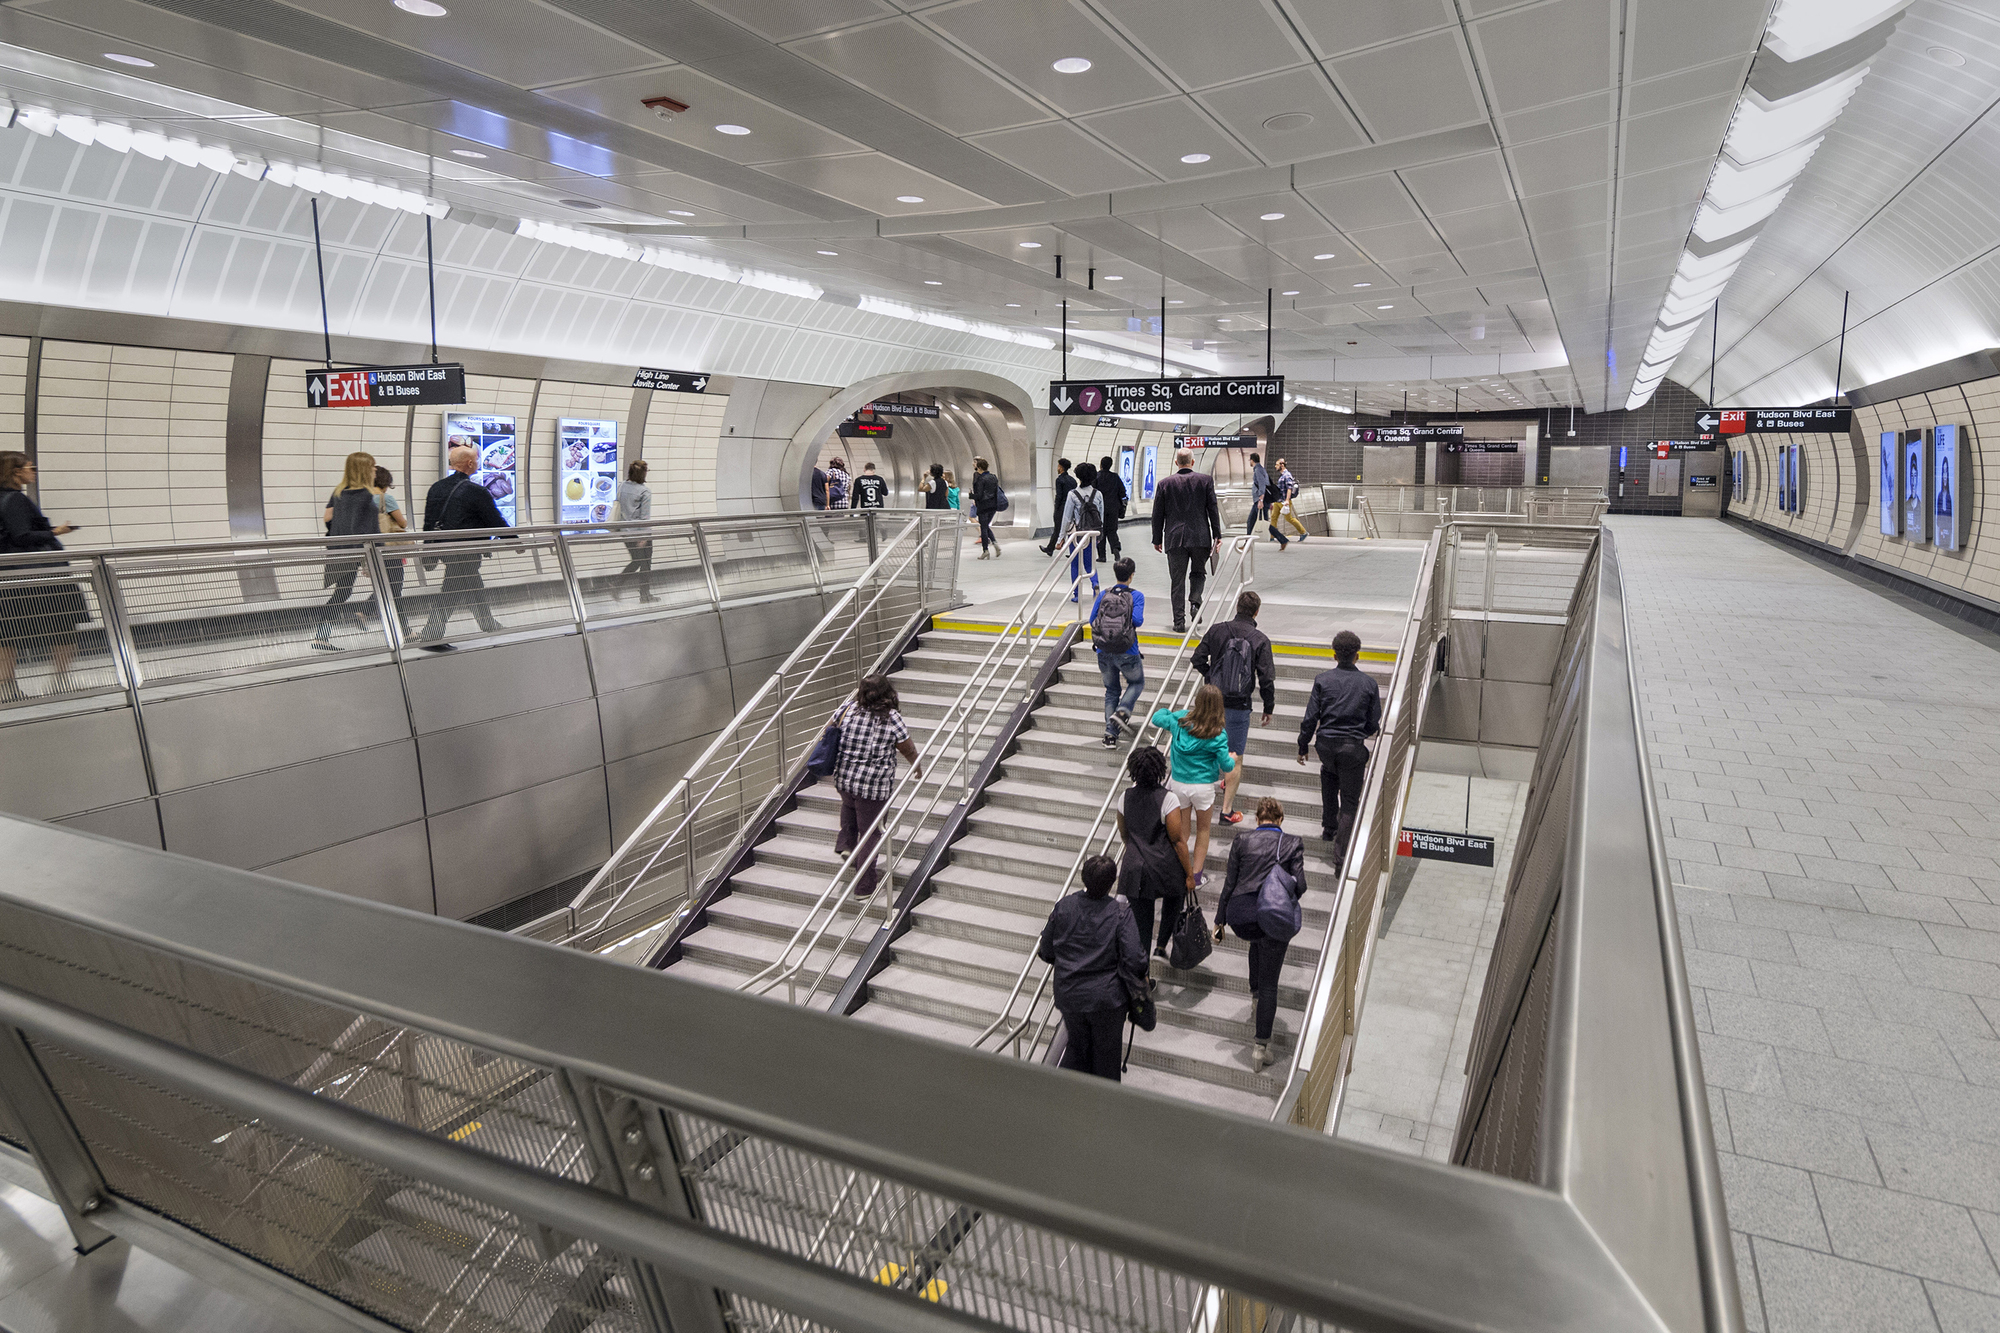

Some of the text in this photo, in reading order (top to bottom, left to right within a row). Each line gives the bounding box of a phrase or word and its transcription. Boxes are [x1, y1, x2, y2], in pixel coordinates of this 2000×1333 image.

[377, 369, 446, 382] Hudson Blvd East
[636, 370, 669, 380] High Line
[326, 373, 369, 400] Exit
[378, 385, 420, 396] & Buses
[633, 380, 680, 390] Javits Center
[1105, 381, 1279, 399] Times Sq, Grand Central
[1085, 392, 1096, 407] 7
[873, 403, 890, 411] Hudson
[1104, 399, 1172, 412] & Queens
[1720, 411, 1745, 421] Exit
[1756, 410, 1836, 419] Hudson Blvd East
[1777, 420, 1805, 428] Buses
[1399, 428, 1411, 436] Sq,
[1413, 427, 1434, 435] Grand
[1436, 427, 1463, 435] Central
[1183, 437, 1204, 447] Exit
[867, 487, 876, 501] 9
[1399, 832, 1411, 843] it
[1412, 833, 1488, 849] Hudson Blvd East
[1412, 840, 1455, 853] & Buses
